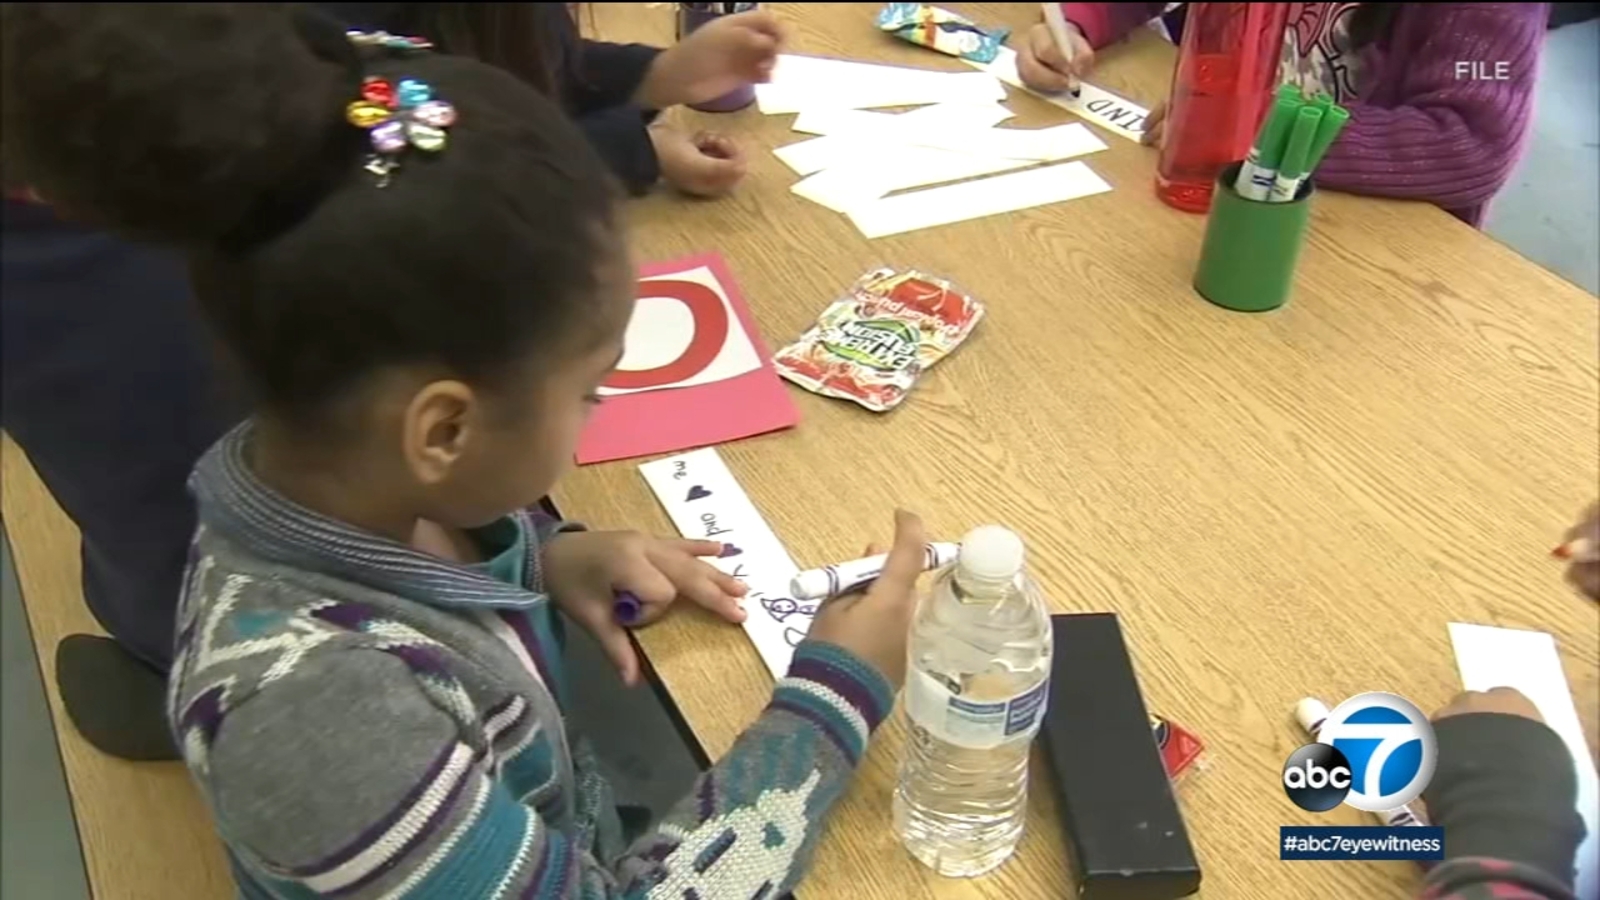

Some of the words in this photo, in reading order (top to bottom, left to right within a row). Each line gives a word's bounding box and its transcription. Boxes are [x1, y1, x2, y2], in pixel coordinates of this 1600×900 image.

[1087, 99, 1145, 132] IND
[672, 460, 688, 480] me
[700, 512, 733, 537] and
